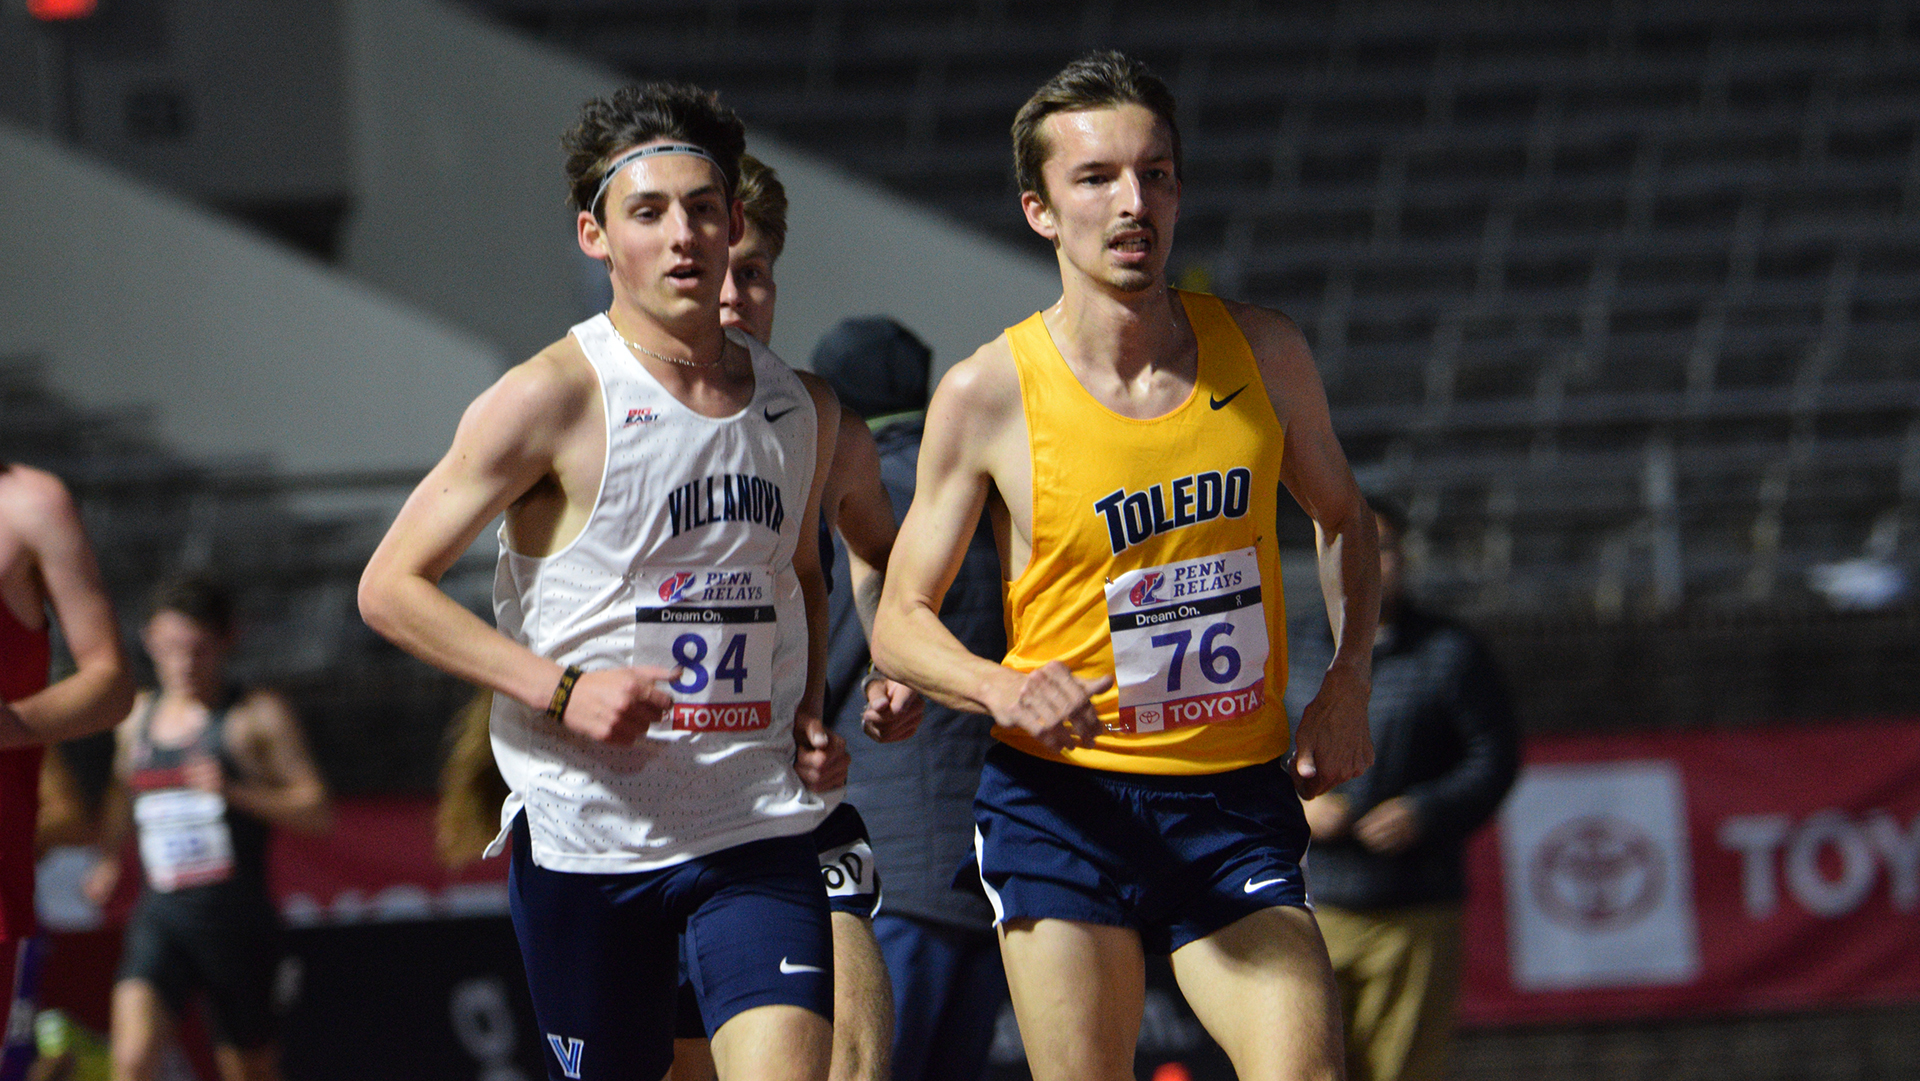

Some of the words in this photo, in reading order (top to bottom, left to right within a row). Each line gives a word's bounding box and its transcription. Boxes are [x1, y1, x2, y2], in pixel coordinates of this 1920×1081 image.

[625, 414, 660, 423] EAST
[627, 407, 652, 417] BIG
[669, 474, 784, 538] VILLANOVA
[1094, 467, 1251, 556] TOLEDO
[705, 572, 752, 585] PENN
[1173, 559, 1226, 581] PENN
[702, 586, 762, 600] RELAYS
[1173, 571, 1242, 597] RELAYS
[661, 609, 700, 622] Dream
[702, 610, 724, 622] On.
[1136, 607, 1176, 626] Dream
[1178, 605, 1200, 620] On.
[668, 632, 748, 694] 84
[1151, 622, 1241, 692] 76
[679, 708, 760, 728] TOYOTA
[1169, 690, 1259, 722] TOYOTA
[1716, 807, 1920, 920] TOY
[547, 1033, 585, 1079] V
